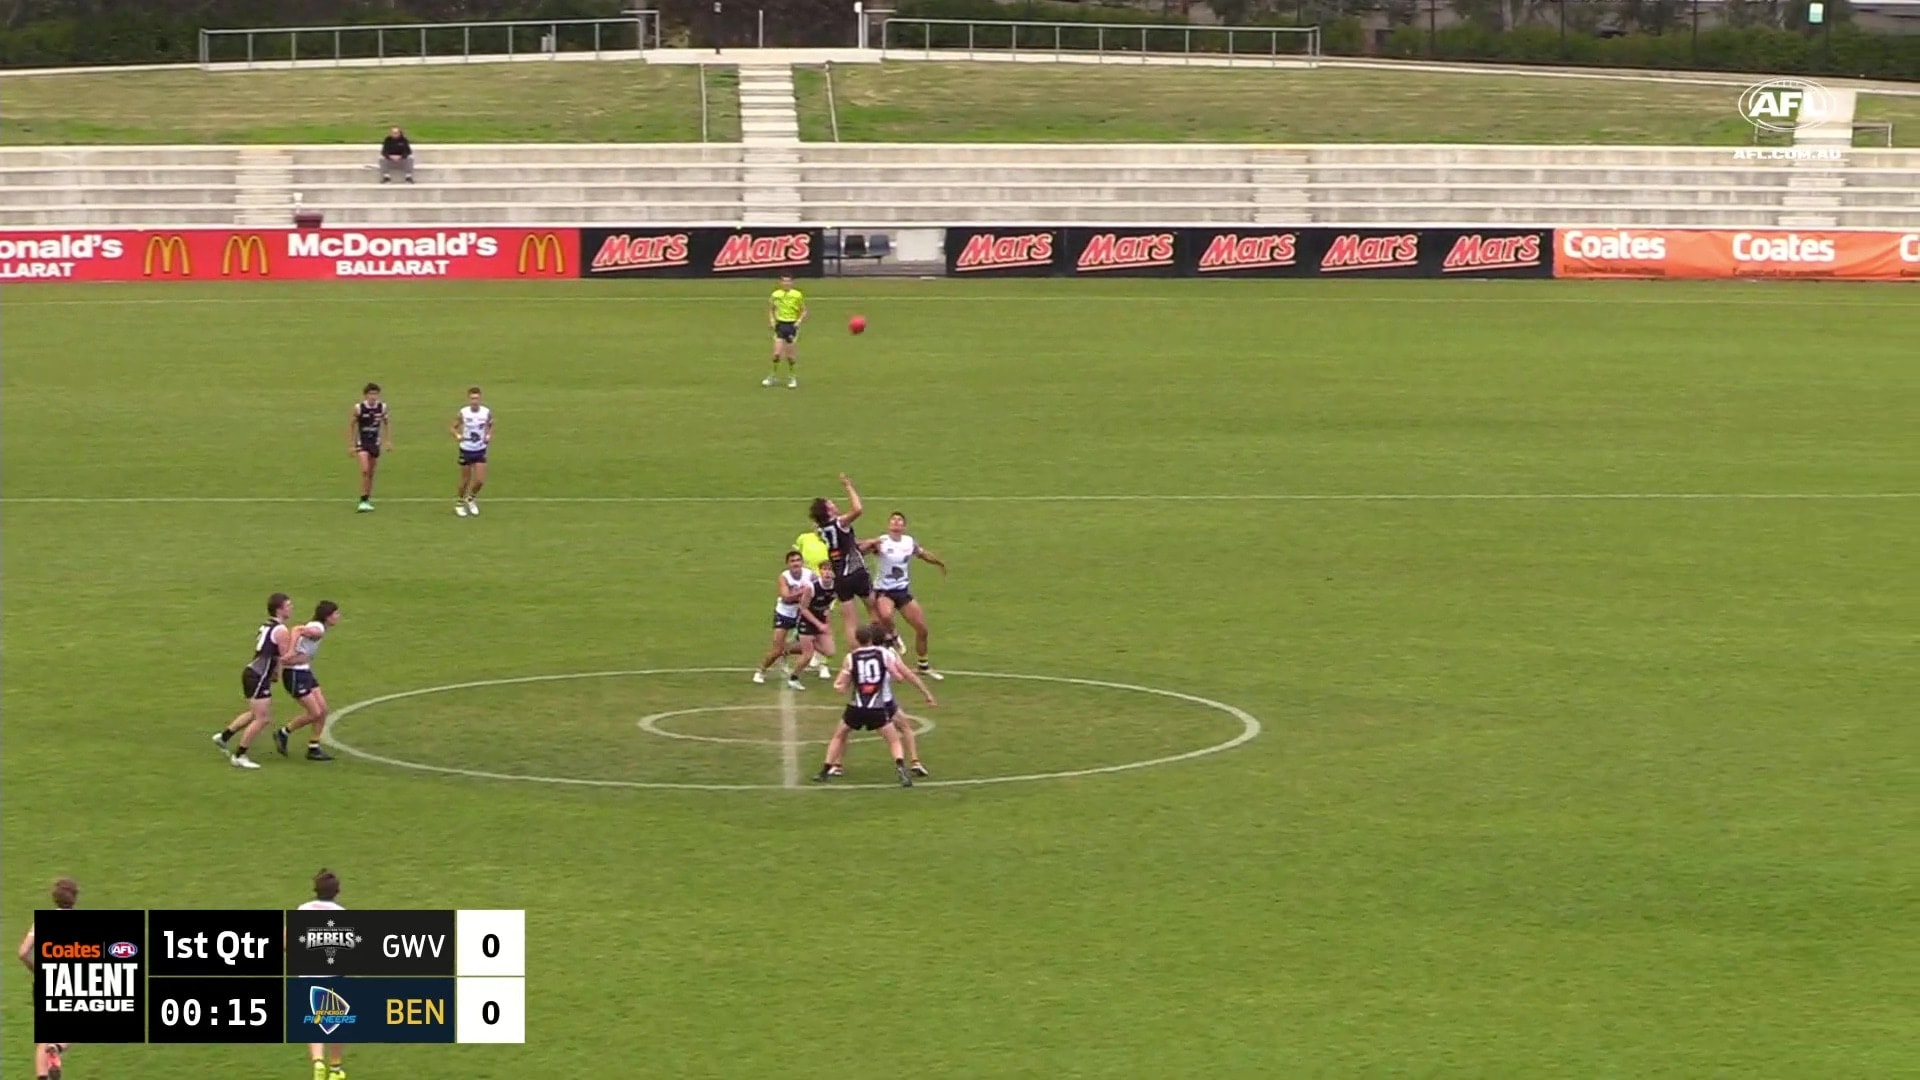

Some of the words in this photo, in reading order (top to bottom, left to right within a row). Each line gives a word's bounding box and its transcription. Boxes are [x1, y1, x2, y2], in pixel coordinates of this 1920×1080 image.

[288, 233, 498, 256] McDonald's
[592, 234, 688, 267] Mars
[714, 234, 810, 267] Mars
[957, 234, 1052, 266] Mars
[1078, 234, 1173, 266] Mars
[1200, 234, 1295, 266] Mars
[1322, 234, 1418, 266] Mars
[1443, 235, 1539, 267] Mars
[1564, 231, 1666, 259] Coates
[1732, 233, 1835, 262] Coates
[1900, 234, 1920, 262] C
[336, 260, 449, 275] BALLARAT
[856, 658, 881, 684] 10
